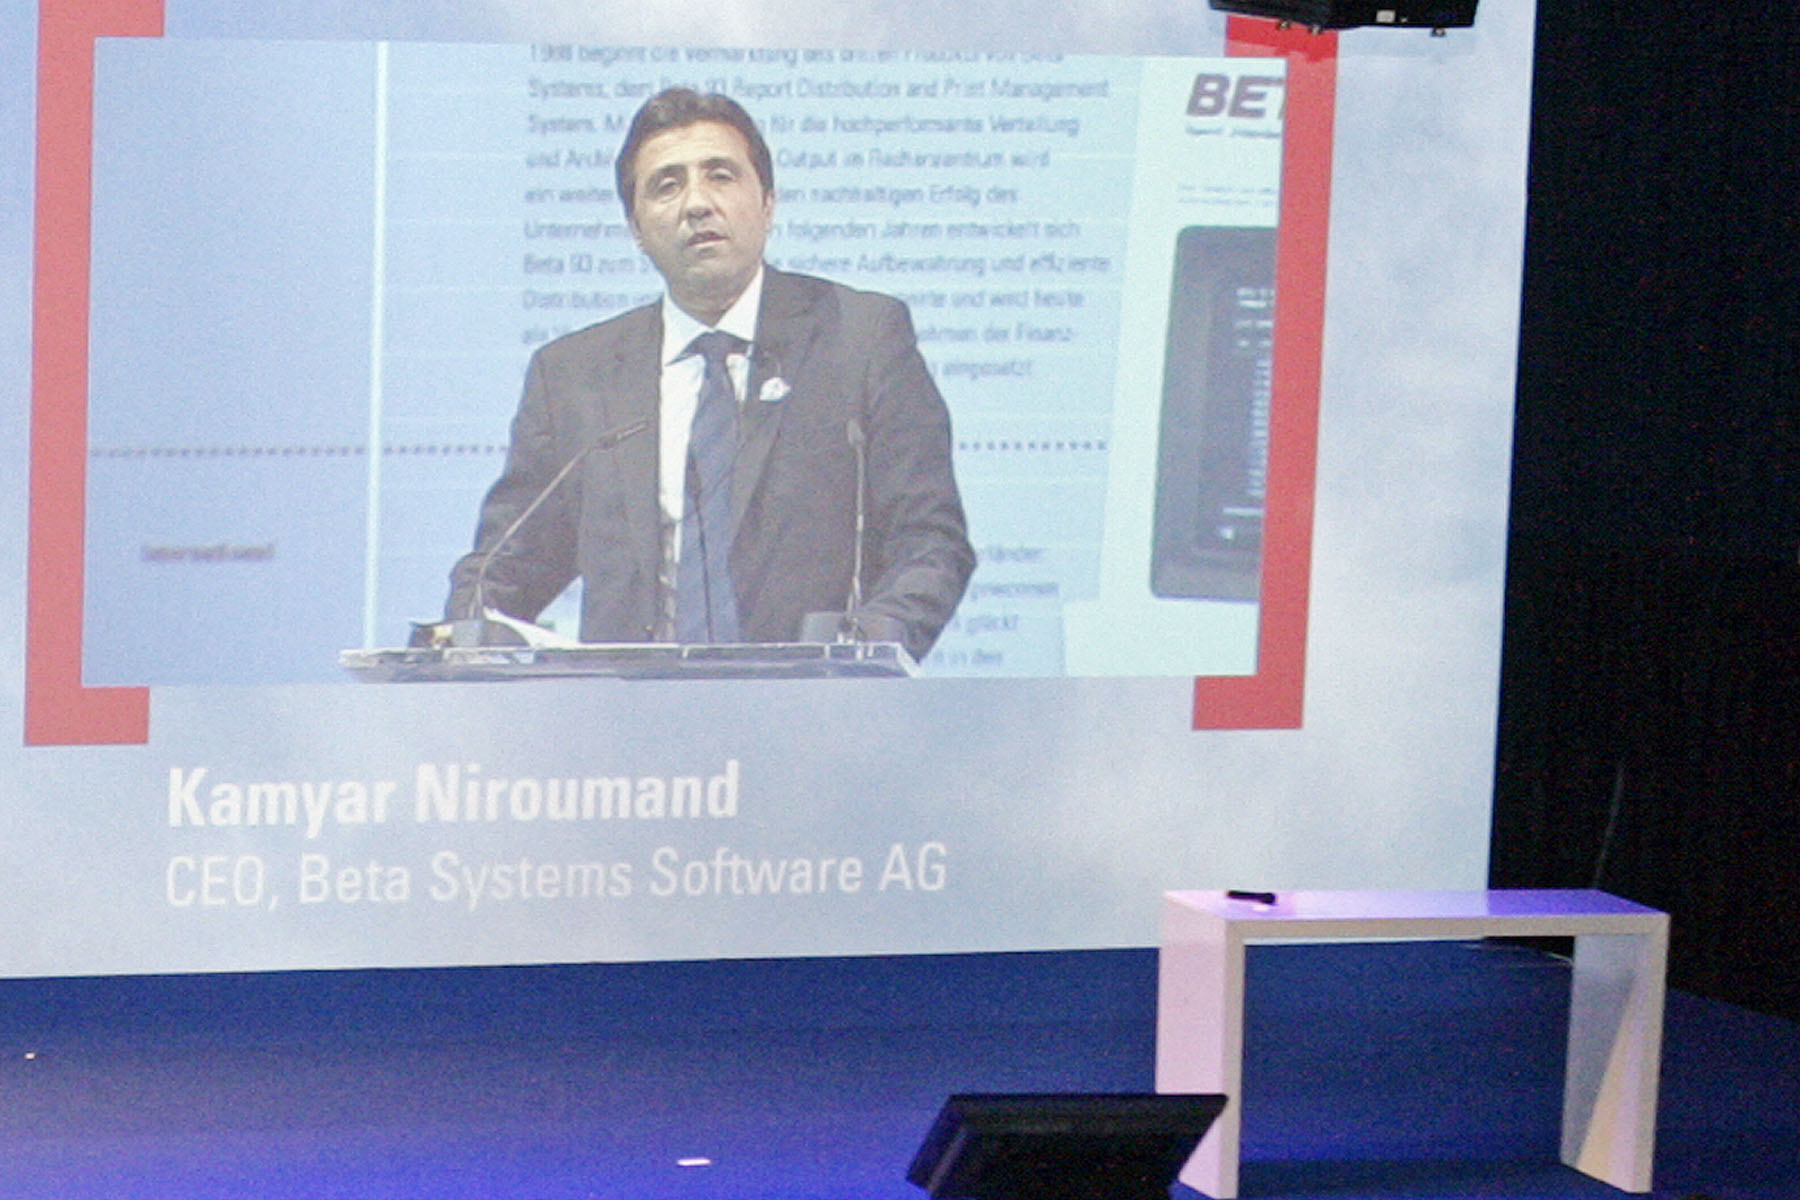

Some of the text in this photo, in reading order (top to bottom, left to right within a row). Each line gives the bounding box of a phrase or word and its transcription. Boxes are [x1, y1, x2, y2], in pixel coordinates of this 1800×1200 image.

[167, 759, 741, 840] Kamyar Niroumand
[164, 842, 949, 913] CEO, Beta Systems Software AG
